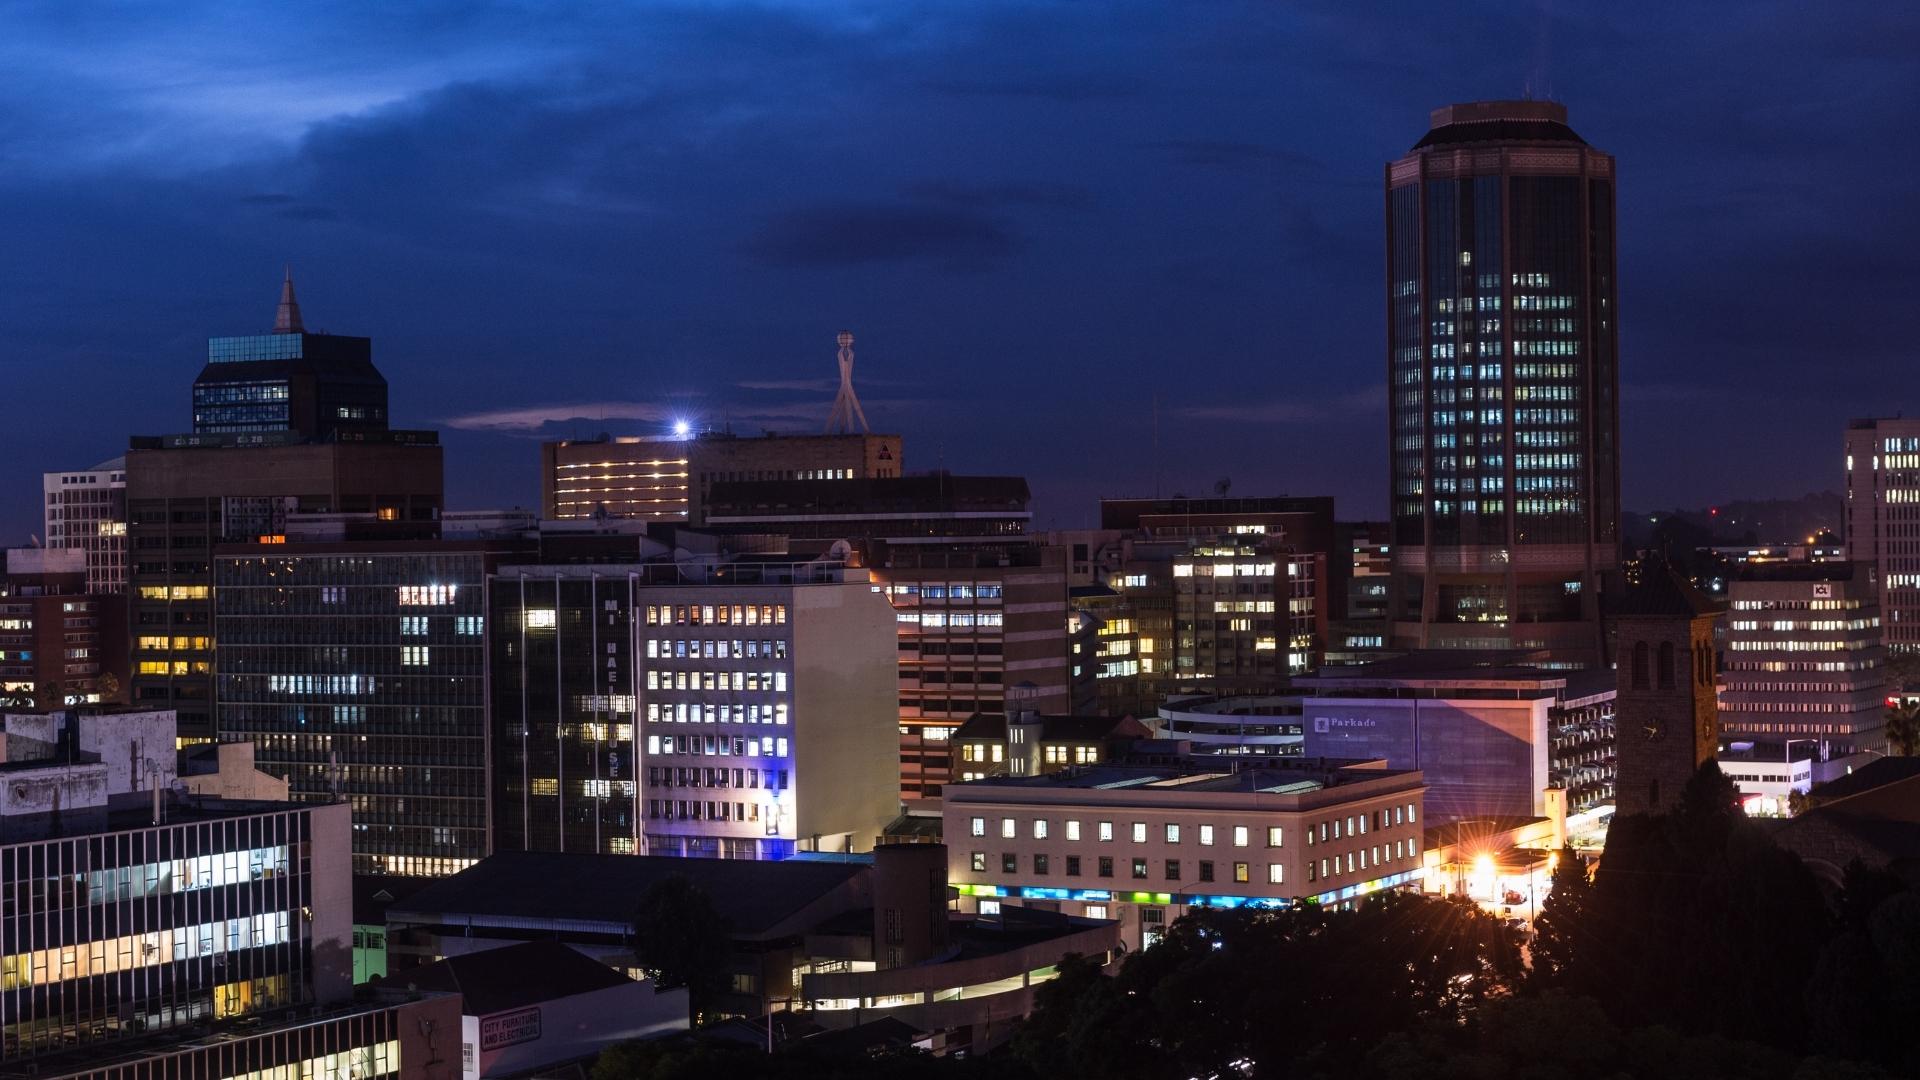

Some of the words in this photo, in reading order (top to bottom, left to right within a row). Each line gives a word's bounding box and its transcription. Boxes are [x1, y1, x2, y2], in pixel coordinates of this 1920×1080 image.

[1331, 717, 1376, 727] Parkade
[484, 1021, 500, 1034] CITY
[484, 1033, 498, 1045] AND
